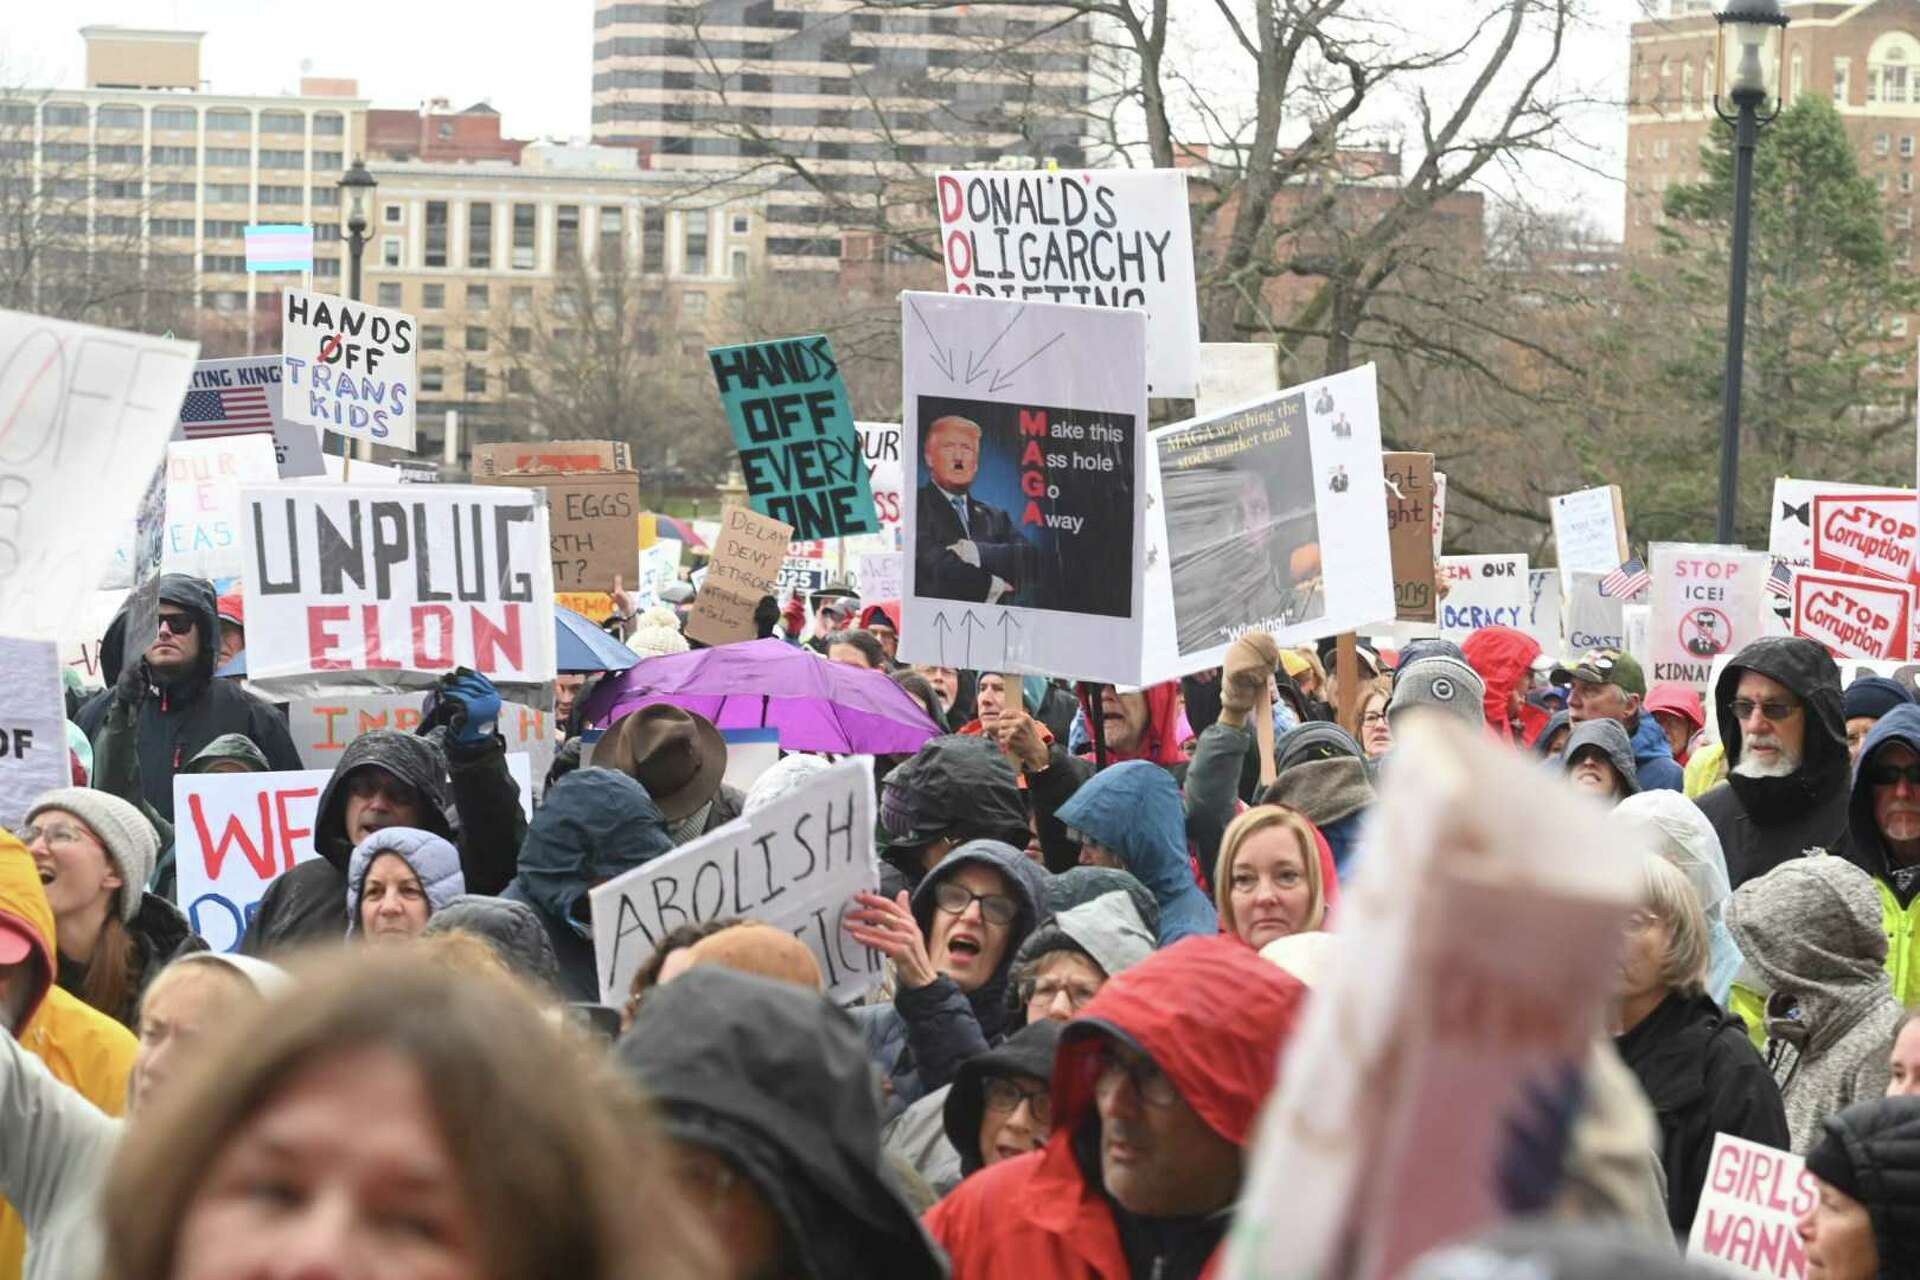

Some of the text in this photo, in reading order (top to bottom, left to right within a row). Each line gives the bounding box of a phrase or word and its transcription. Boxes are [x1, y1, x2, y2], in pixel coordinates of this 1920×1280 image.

[947, 227, 1171, 282] OLIGARCHY
[288, 293, 413, 354] HANDS
[237, 365, 283, 386] KING
[317, 333, 384, 375] OFF
[710, 335, 838, 394] HANDS
[285, 357, 408, 416] TRANS
[1277, 401, 1300, 417] the
[310, 390, 389, 438] KIDS
[740, 389, 836, 444] OFF
[1089, 423, 1124, 442] this
[738, 432, 863, 497] EVERY
[857, 430, 900, 461] UR
[1073, 451, 1114, 472] hole
[1177, 422, 1293, 470] stock market tank
[566, 492, 632, 521] EGGS
[766, 485, 868, 542] ONE
[1845, 506, 1917, 539] STOP
[252, 498, 534, 602] UNPLUG
[728, 540, 773, 568] DENY
[1825, 508, 1910, 567] Corruption
[1482, 562, 1517, 578] OUR
[1674, 560, 1740, 579] STOP
[1685, 585, 1725, 602] ICE!
[1440, 604, 1521, 629] OCRACY
[1805, 591, 1883, 659] Corruption
[1823, 590, 1890, 631] STOP
[307, 603, 524, 673] ELON
[609, 790, 855, 989] ABOLISH
[1712, 1144, 1821, 1219] GIRLS
